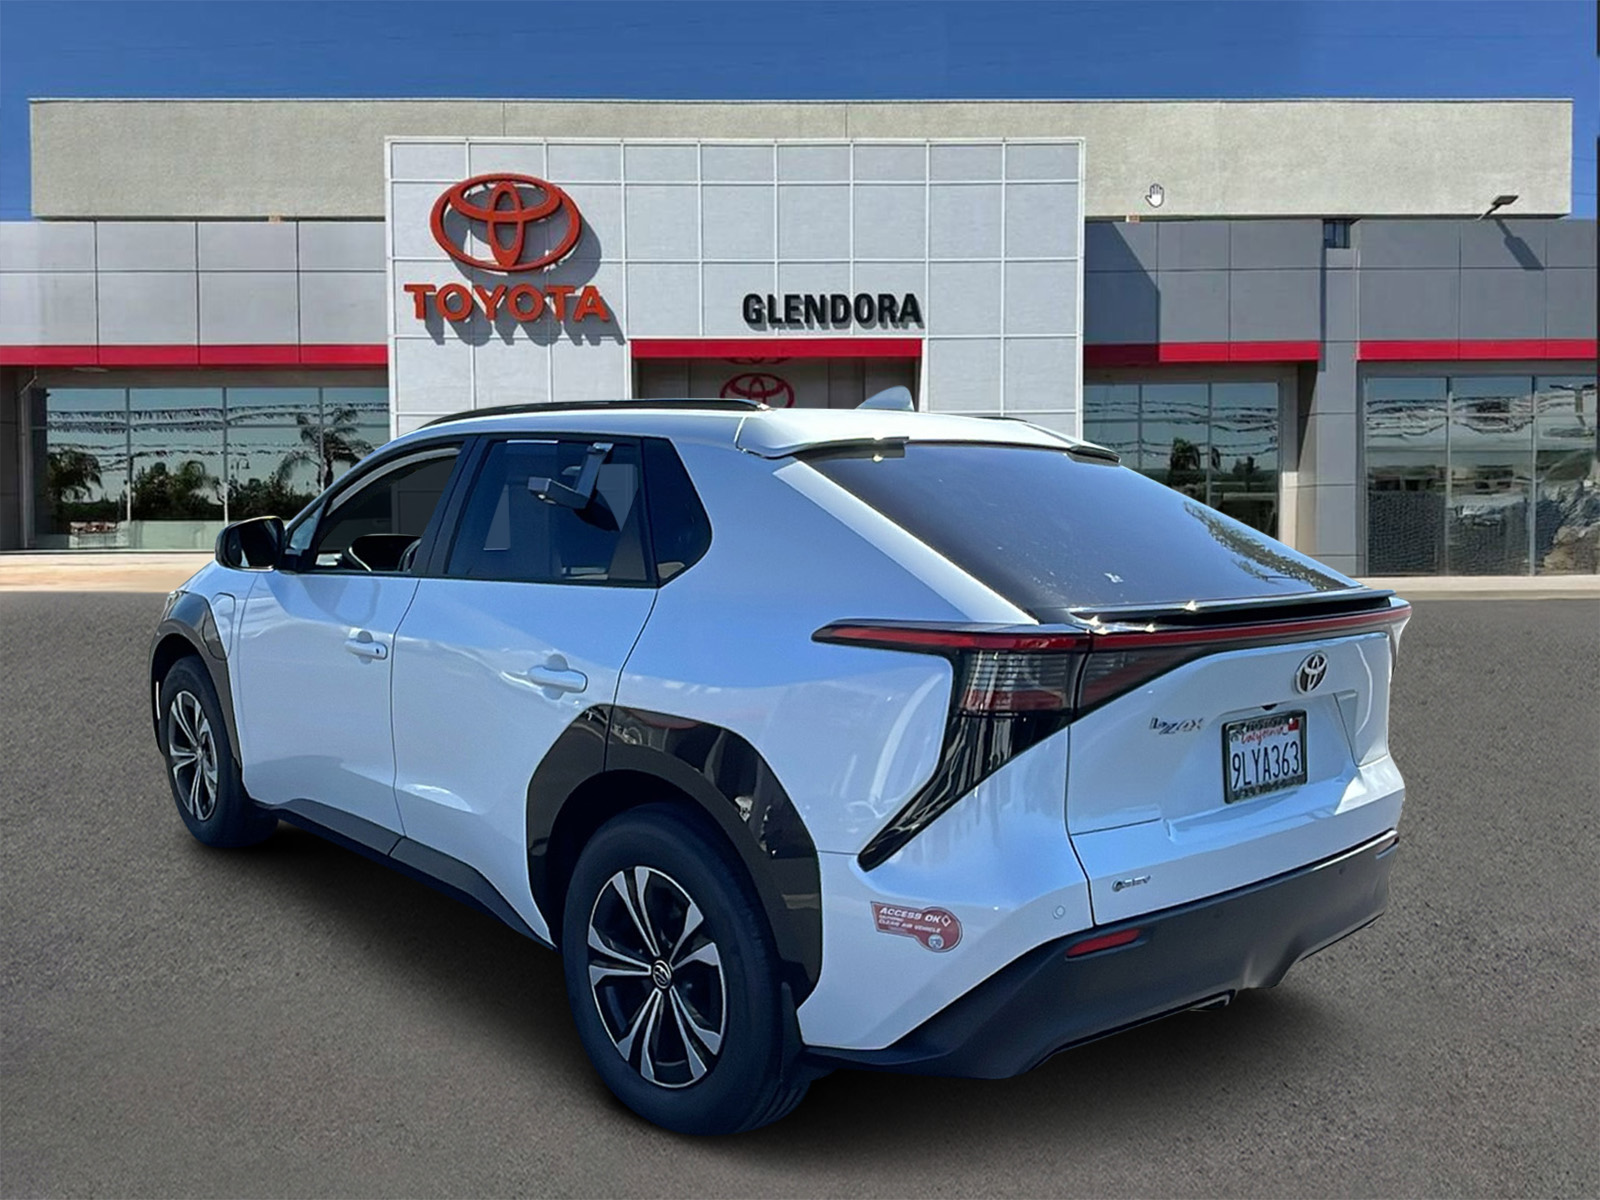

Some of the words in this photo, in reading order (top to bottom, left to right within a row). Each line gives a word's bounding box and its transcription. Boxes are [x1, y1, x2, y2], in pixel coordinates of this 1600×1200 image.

[404, 284, 610, 323] TOYOTA
[742, 293, 923, 326] GLENDORA
[1232, 741, 1300, 789] 9LYA363
[880, 907, 922, 920] ACCESS
[925, 914, 941, 923] OK
